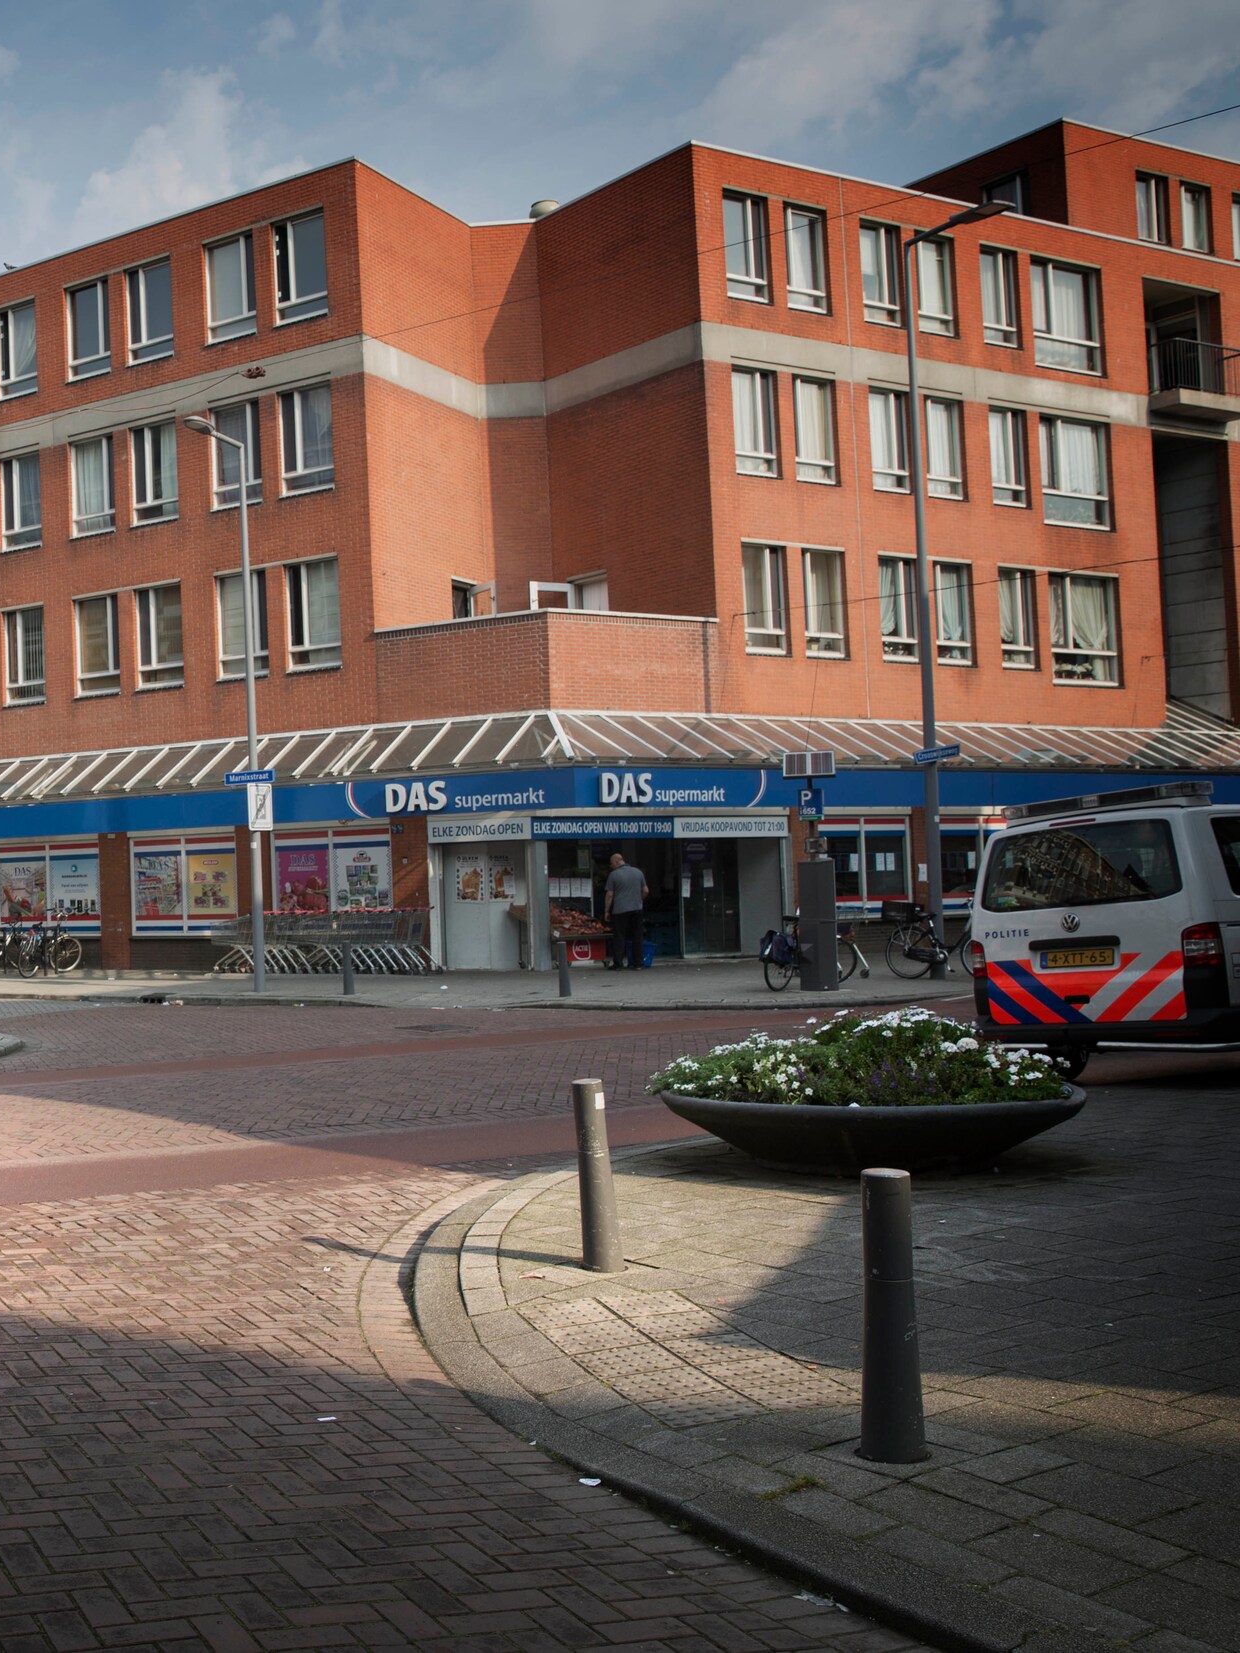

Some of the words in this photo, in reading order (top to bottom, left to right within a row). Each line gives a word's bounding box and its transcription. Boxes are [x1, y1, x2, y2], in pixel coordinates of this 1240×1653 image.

[229, 773, 269, 781] Marnixstraat
[601, 772, 653, 803] DAS
[655, 786, 725, 806] supermarkt
[385, 780, 447, 814] DAS
[455, 787, 545, 811] supermarkt
[801, 790, 812, 806] P
[803, 807, 816, 815] 652
[432, 826, 453, 837] ELKE
[455, 824, 496, 836] ZONDAG
[498, 823, 524, 835] OPEN
[533, 822, 551, 834] ELKE
[552, 822, 582, 834] ZONDAG
[583, 822, 602, 834] OPEN
[603, 822, 619, 833] VAN
[620, 822, 638, 833] 10:00
[640, 822, 652, 833] TOT
[654, 822, 672, 833] 19:00
[681, 822, 709, 833] VRIJDAG
[711, 822, 752, 832] KOOPAVOND
[753, 822, 766, 832] TOT
[767, 821, 785, 832] 21:00
[14, 867, 32, 877] DAS
[985, 929, 1030, 939] POLITIE
[1050, 952, 1107, 965] 4-XTT-65
